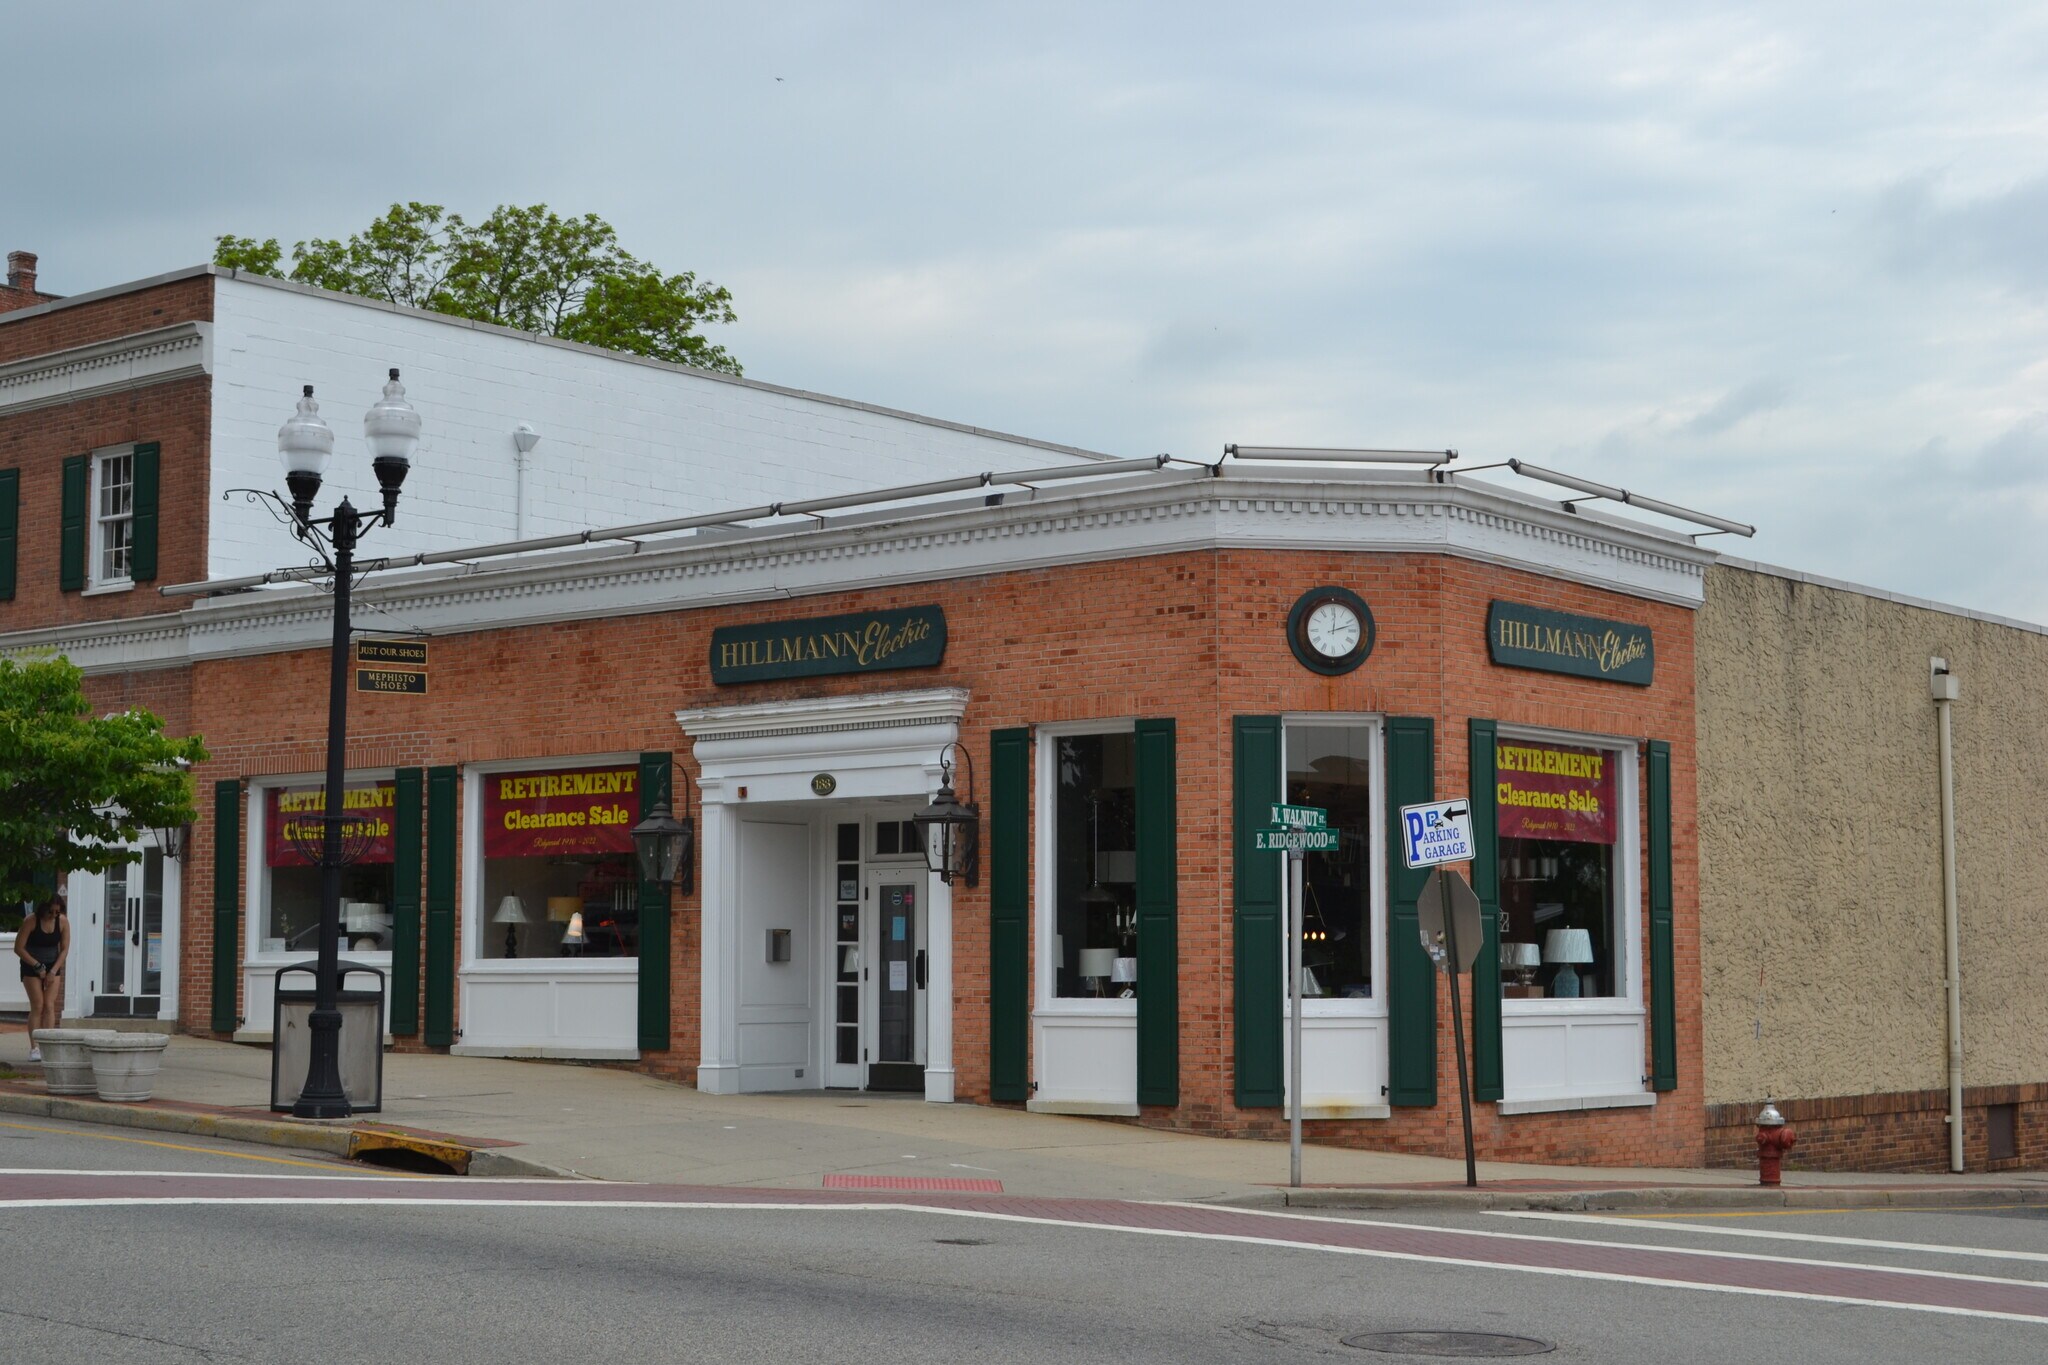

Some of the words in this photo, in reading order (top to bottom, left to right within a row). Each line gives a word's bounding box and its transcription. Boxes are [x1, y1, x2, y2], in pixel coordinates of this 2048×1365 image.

[359, 646, 378, 655] JUST
[380, 647, 398, 656] OUR
[399, 649, 425, 658] SHOES
[720, 630, 861, 668] HILLMANN
[858, 617, 930, 666] Electric
[1499, 618, 1602, 661] HILLMANN
[1600, 629, 1647, 672] Electric
[368, 672, 416, 683] MEPHISTO
[374, 681, 408, 691] SHOES
[1497, 745, 1603, 779] RETIREMENT
[500, 771, 637, 800] RETIREMENT
[1497, 782, 1566, 810] Clearance
[1568, 789, 1599, 813] Sale
[279, 786, 396, 813] RETIMENT
[504, 809, 586, 830] Clearance
[589, 804, 629, 826] Sale
[1271, 806, 1281, 823] N.
[1282, 807, 1319, 827] WALNUT
[1256, 833, 1266, 849] E.
[1268, 832, 1328, 849] RIDGEWOOD
[1425, 841, 1467, 859] GARAGE
